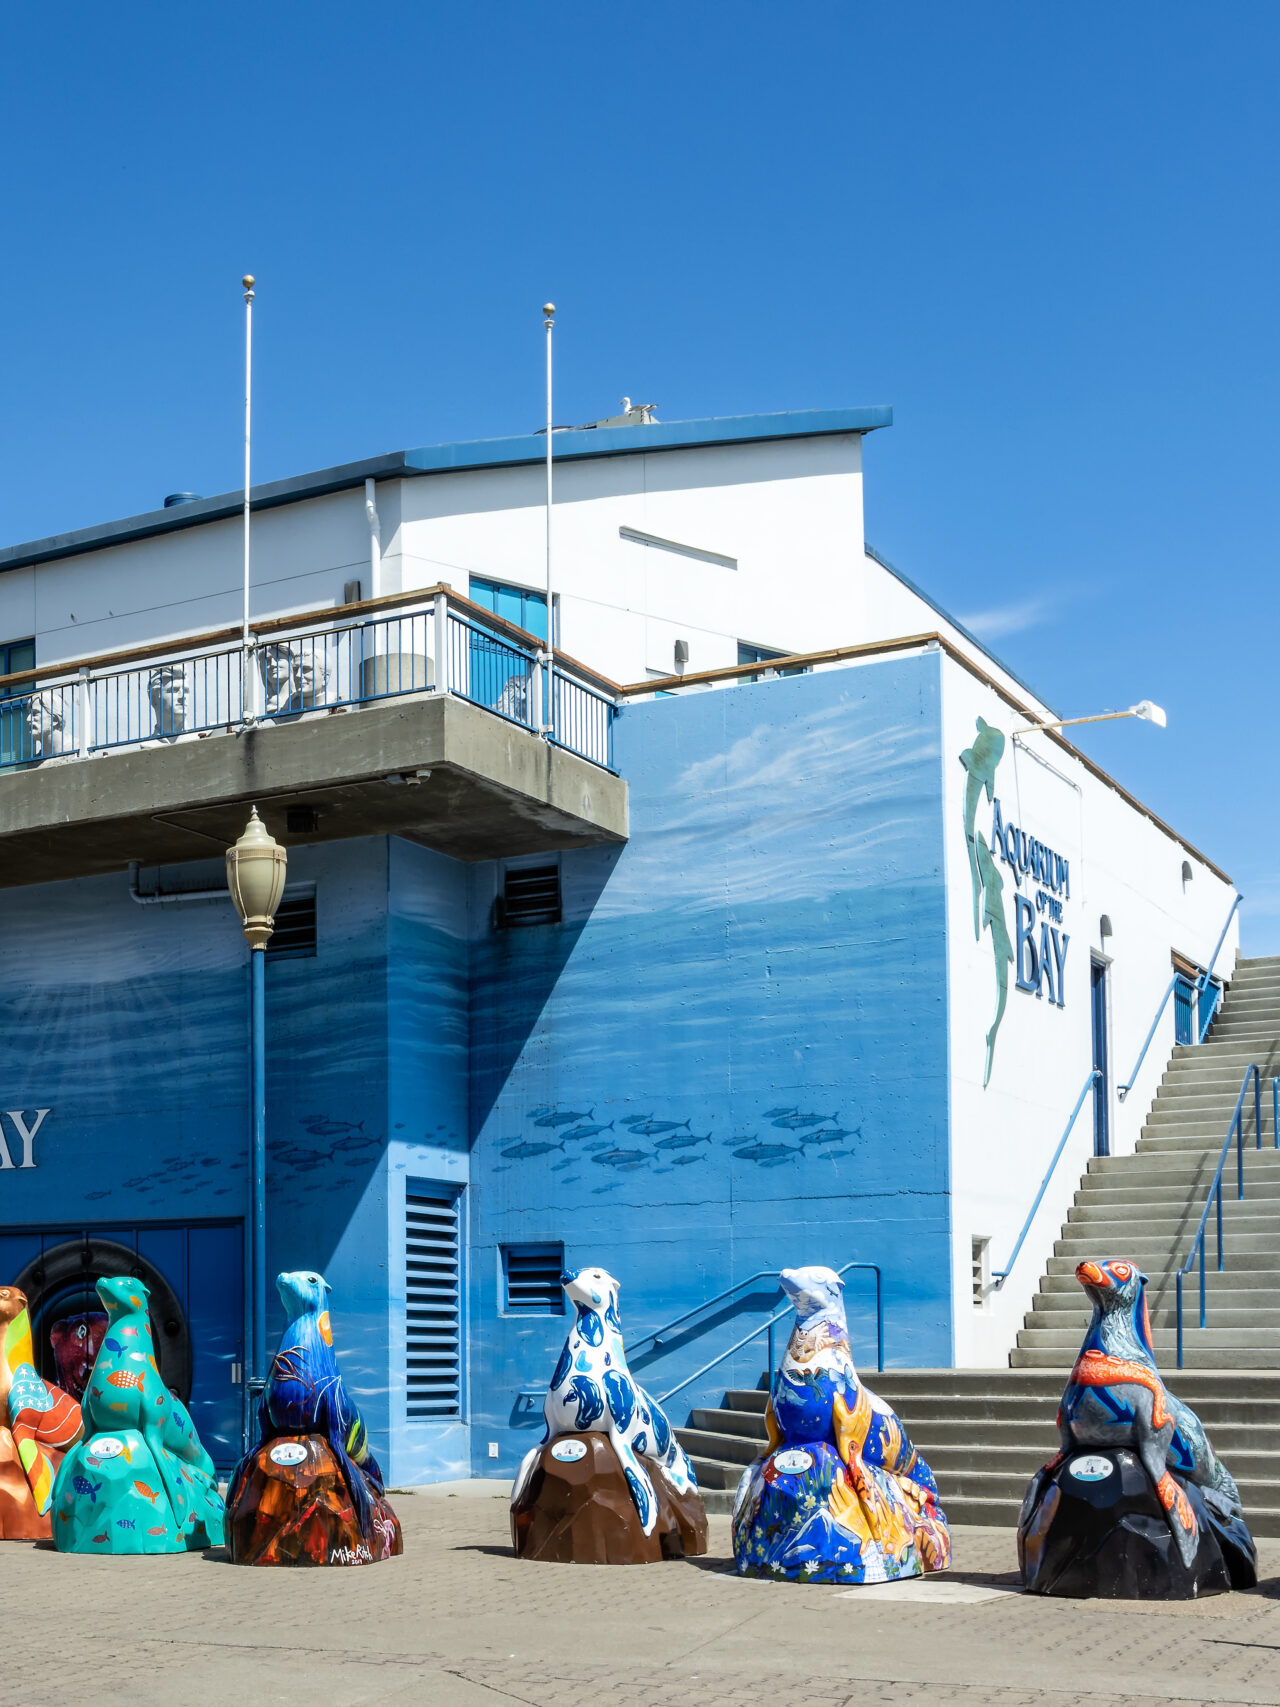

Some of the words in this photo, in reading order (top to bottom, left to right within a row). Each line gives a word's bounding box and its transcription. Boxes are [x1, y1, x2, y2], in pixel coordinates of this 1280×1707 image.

[989, 797, 1070, 899] AQUARIUM
[1035, 889, 1048, 914] OF
[1046, 895, 1064, 924] THE
[1014, 893, 1070, 1008] BAY
[330, 1545, 356, 1564] Mike
